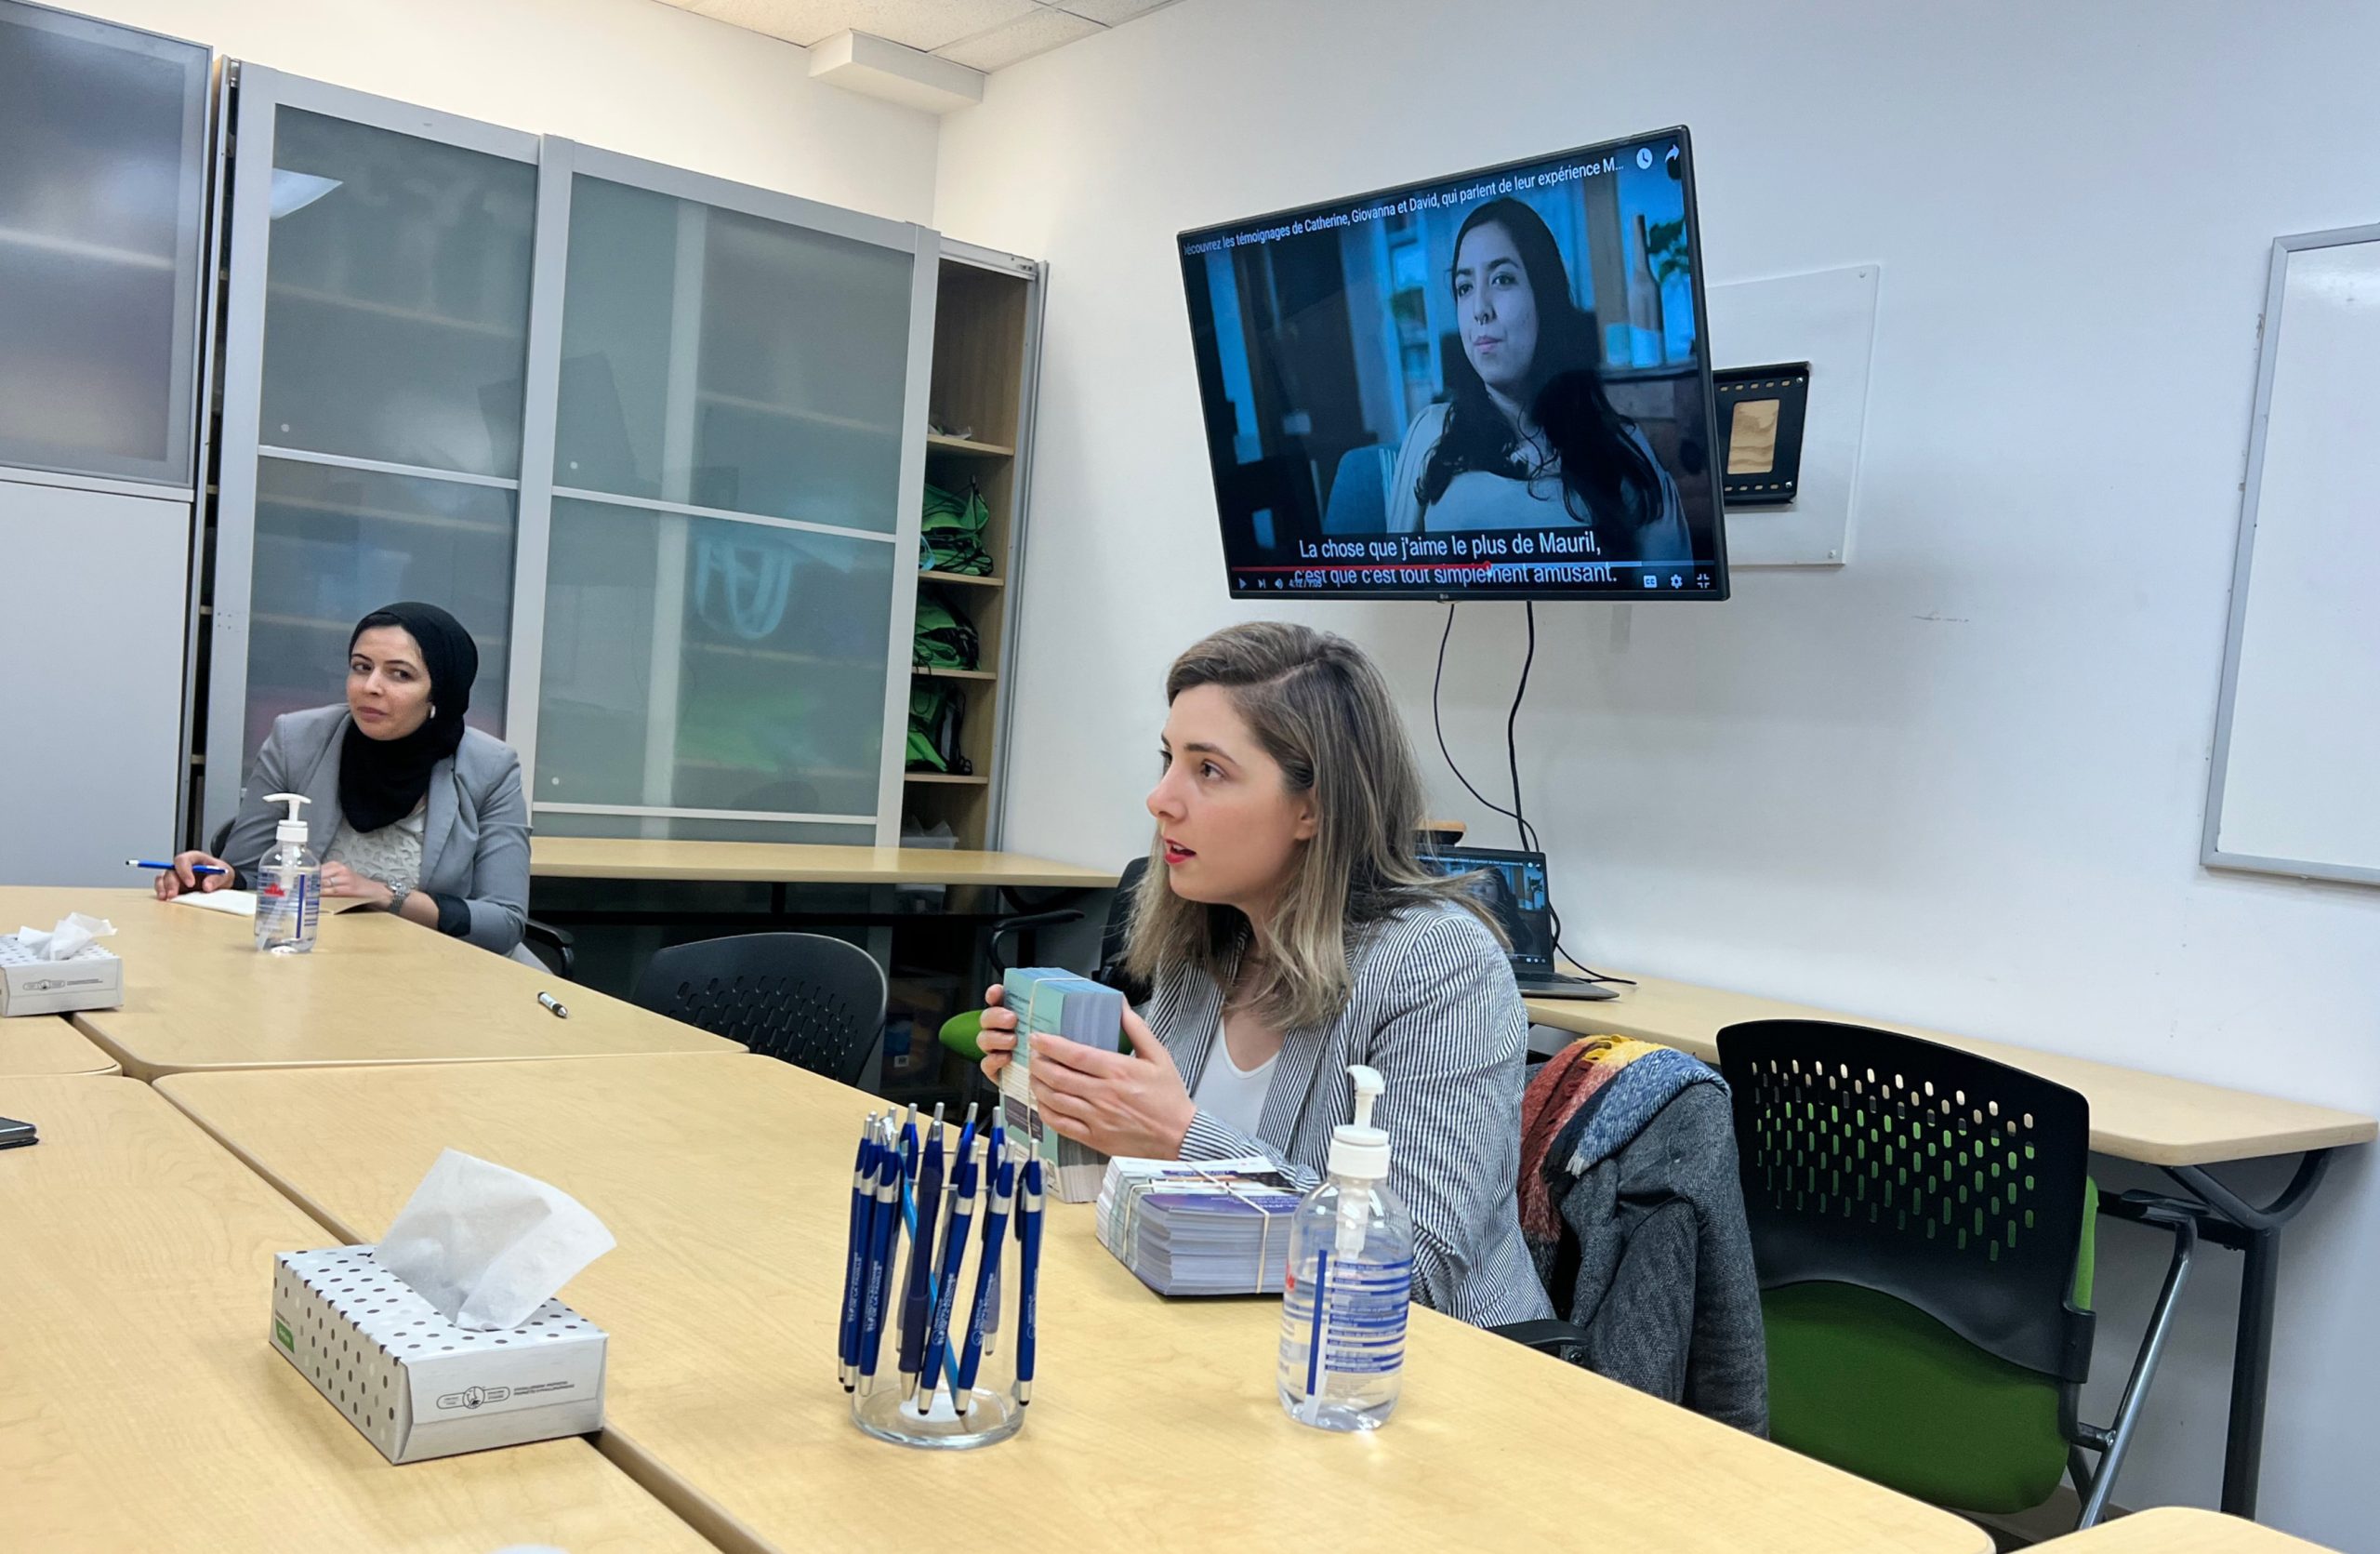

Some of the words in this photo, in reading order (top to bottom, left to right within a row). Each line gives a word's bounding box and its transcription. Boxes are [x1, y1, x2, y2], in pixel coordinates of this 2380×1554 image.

[1222, 235, 1236, 249] les
[1236, 226, 1290, 246] témoignages
[1291, 221, 1303, 234] de
[1304, 213, 1351, 232] Catherine,
[1351, 204, 1396, 223] Giovanna
[1397, 200, 1408, 214] et
[1409, 192, 1440, 212] David,
[1441, 188, 1458, 207] qui
[1460, 182, 1497, 205] parlent
[1498, 178, 1513, 193] de
[1514, 175, 1536, 191] leur
[1538, 162, 1600, 186] expérience
[1603, 156, 1624, 174] M...
[1299, 539, 1318, 558] La
[1321, 538, 1366, 558] chose
[1368, 541, 1398, 562] que
[1400, 536, 1448, 562] j'aime
[1451, 535, 1468, 555] le
[1472, 533, 1507, 560] plus
[1512, 532, 1535, 554] de
[1539, 530, 1602, 555] Mauril,
[1293, 568, 1328, 584] c'est
[1329, 568, 1357, 588] que
[1361, 568, 1397, 584] c'est
[1398, 566, 1431, 584] tout
[1435, 564, 1529, 588] simplement
[1533, 562, 1618, 583] amusant.
